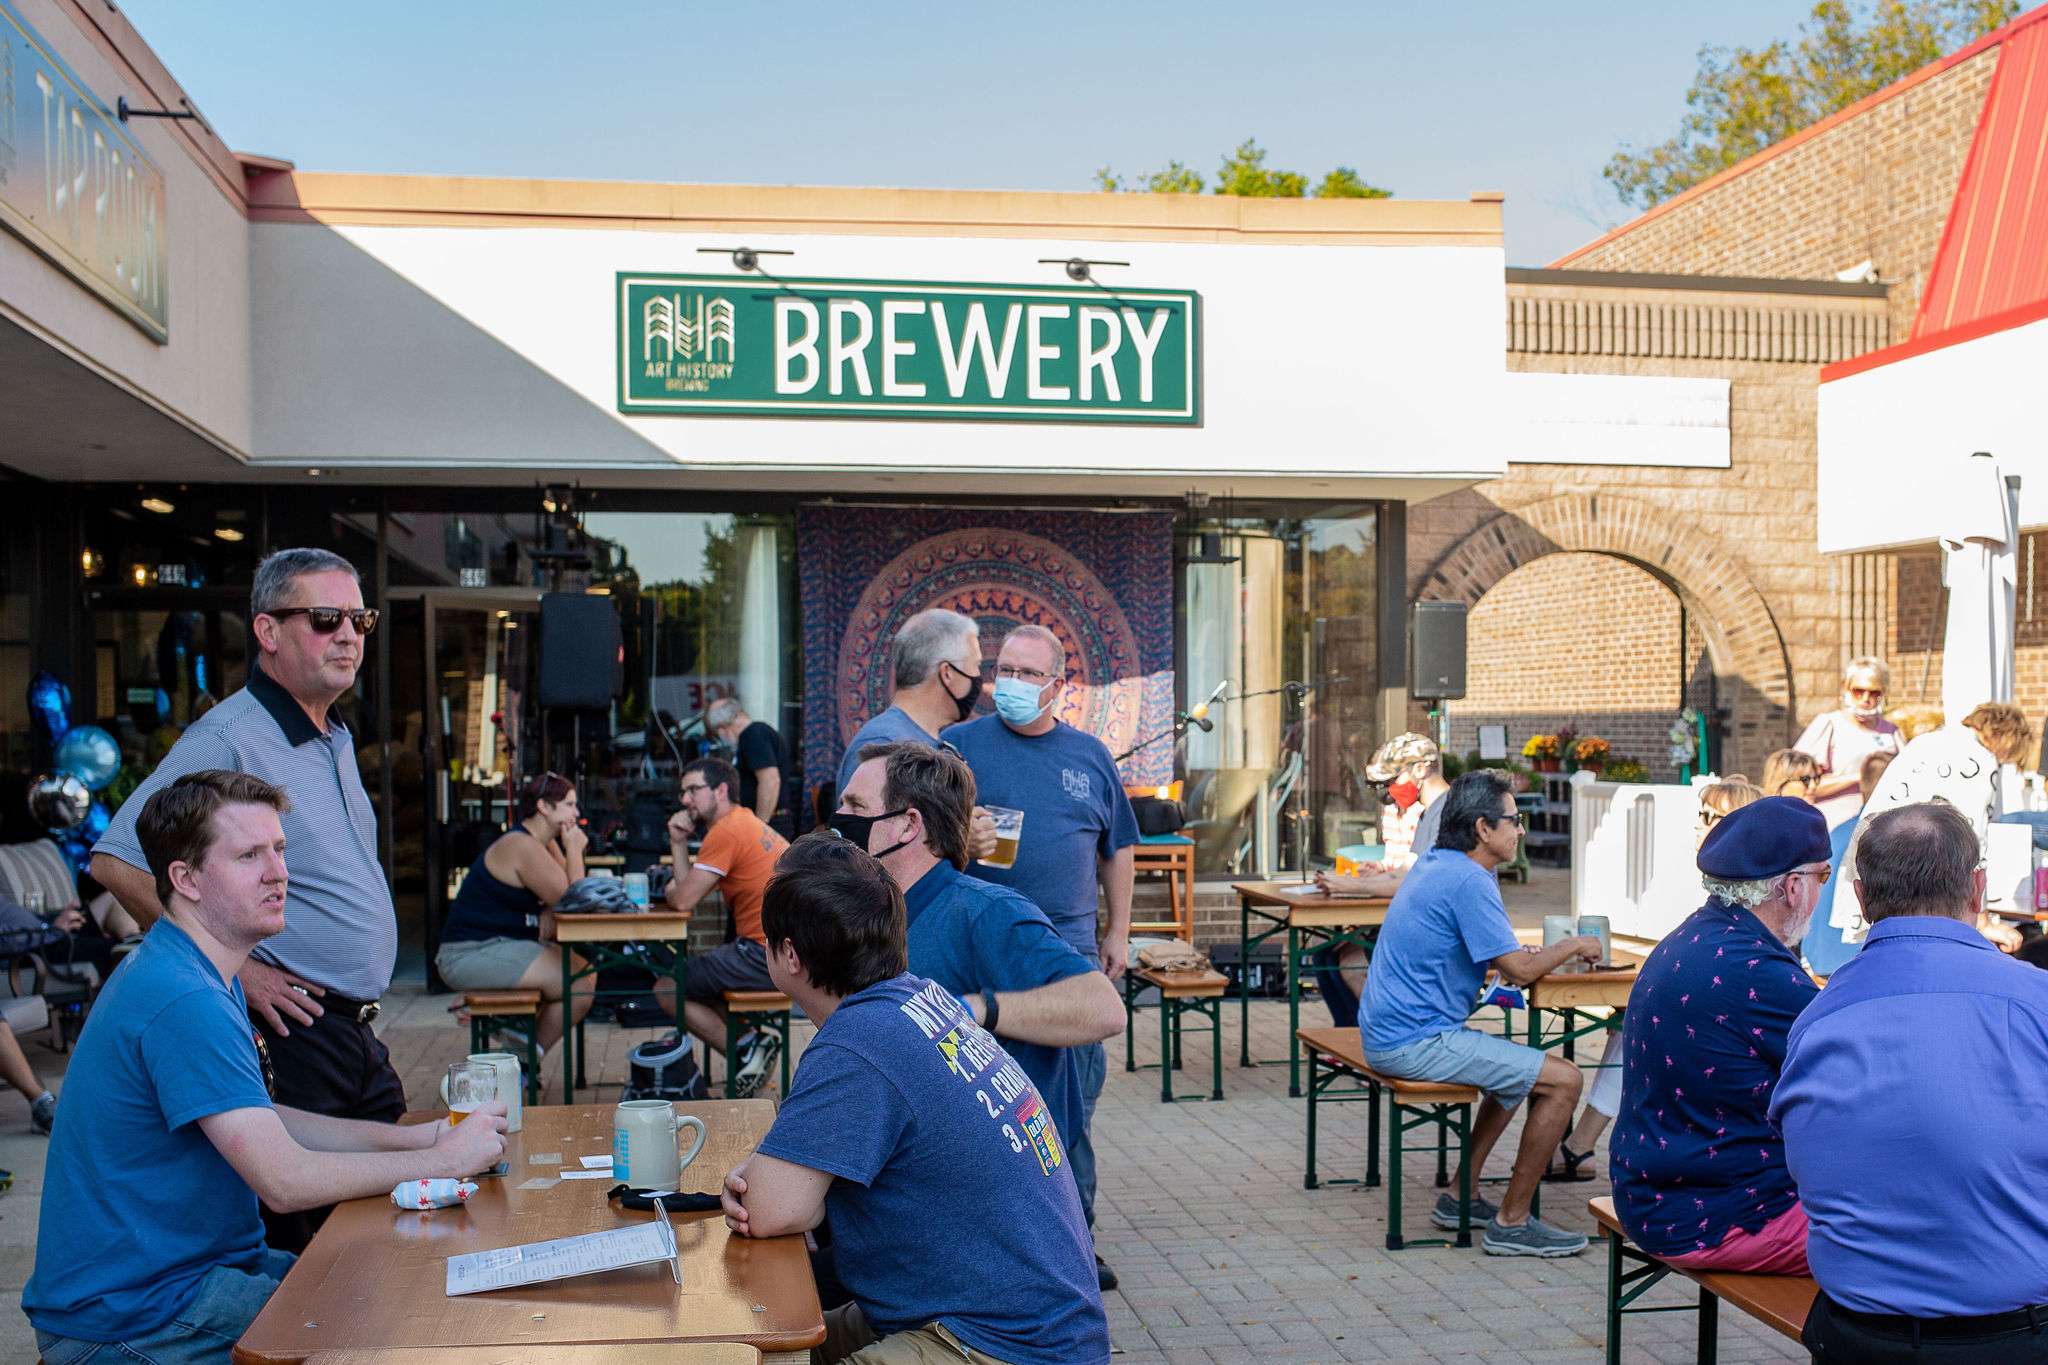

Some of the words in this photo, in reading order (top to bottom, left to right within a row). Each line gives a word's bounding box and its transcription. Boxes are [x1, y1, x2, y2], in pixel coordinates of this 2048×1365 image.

[774, 296, 1171, 403] BREWERY
[645, 361, 672, 378] ART
[676, 362, 734, 380] HISTORY
[950, 1054, 976, 1083] 1.
[976, 1089, 1005, 1119] 2.
[1002, 1123, 1028, 1153] 3.
